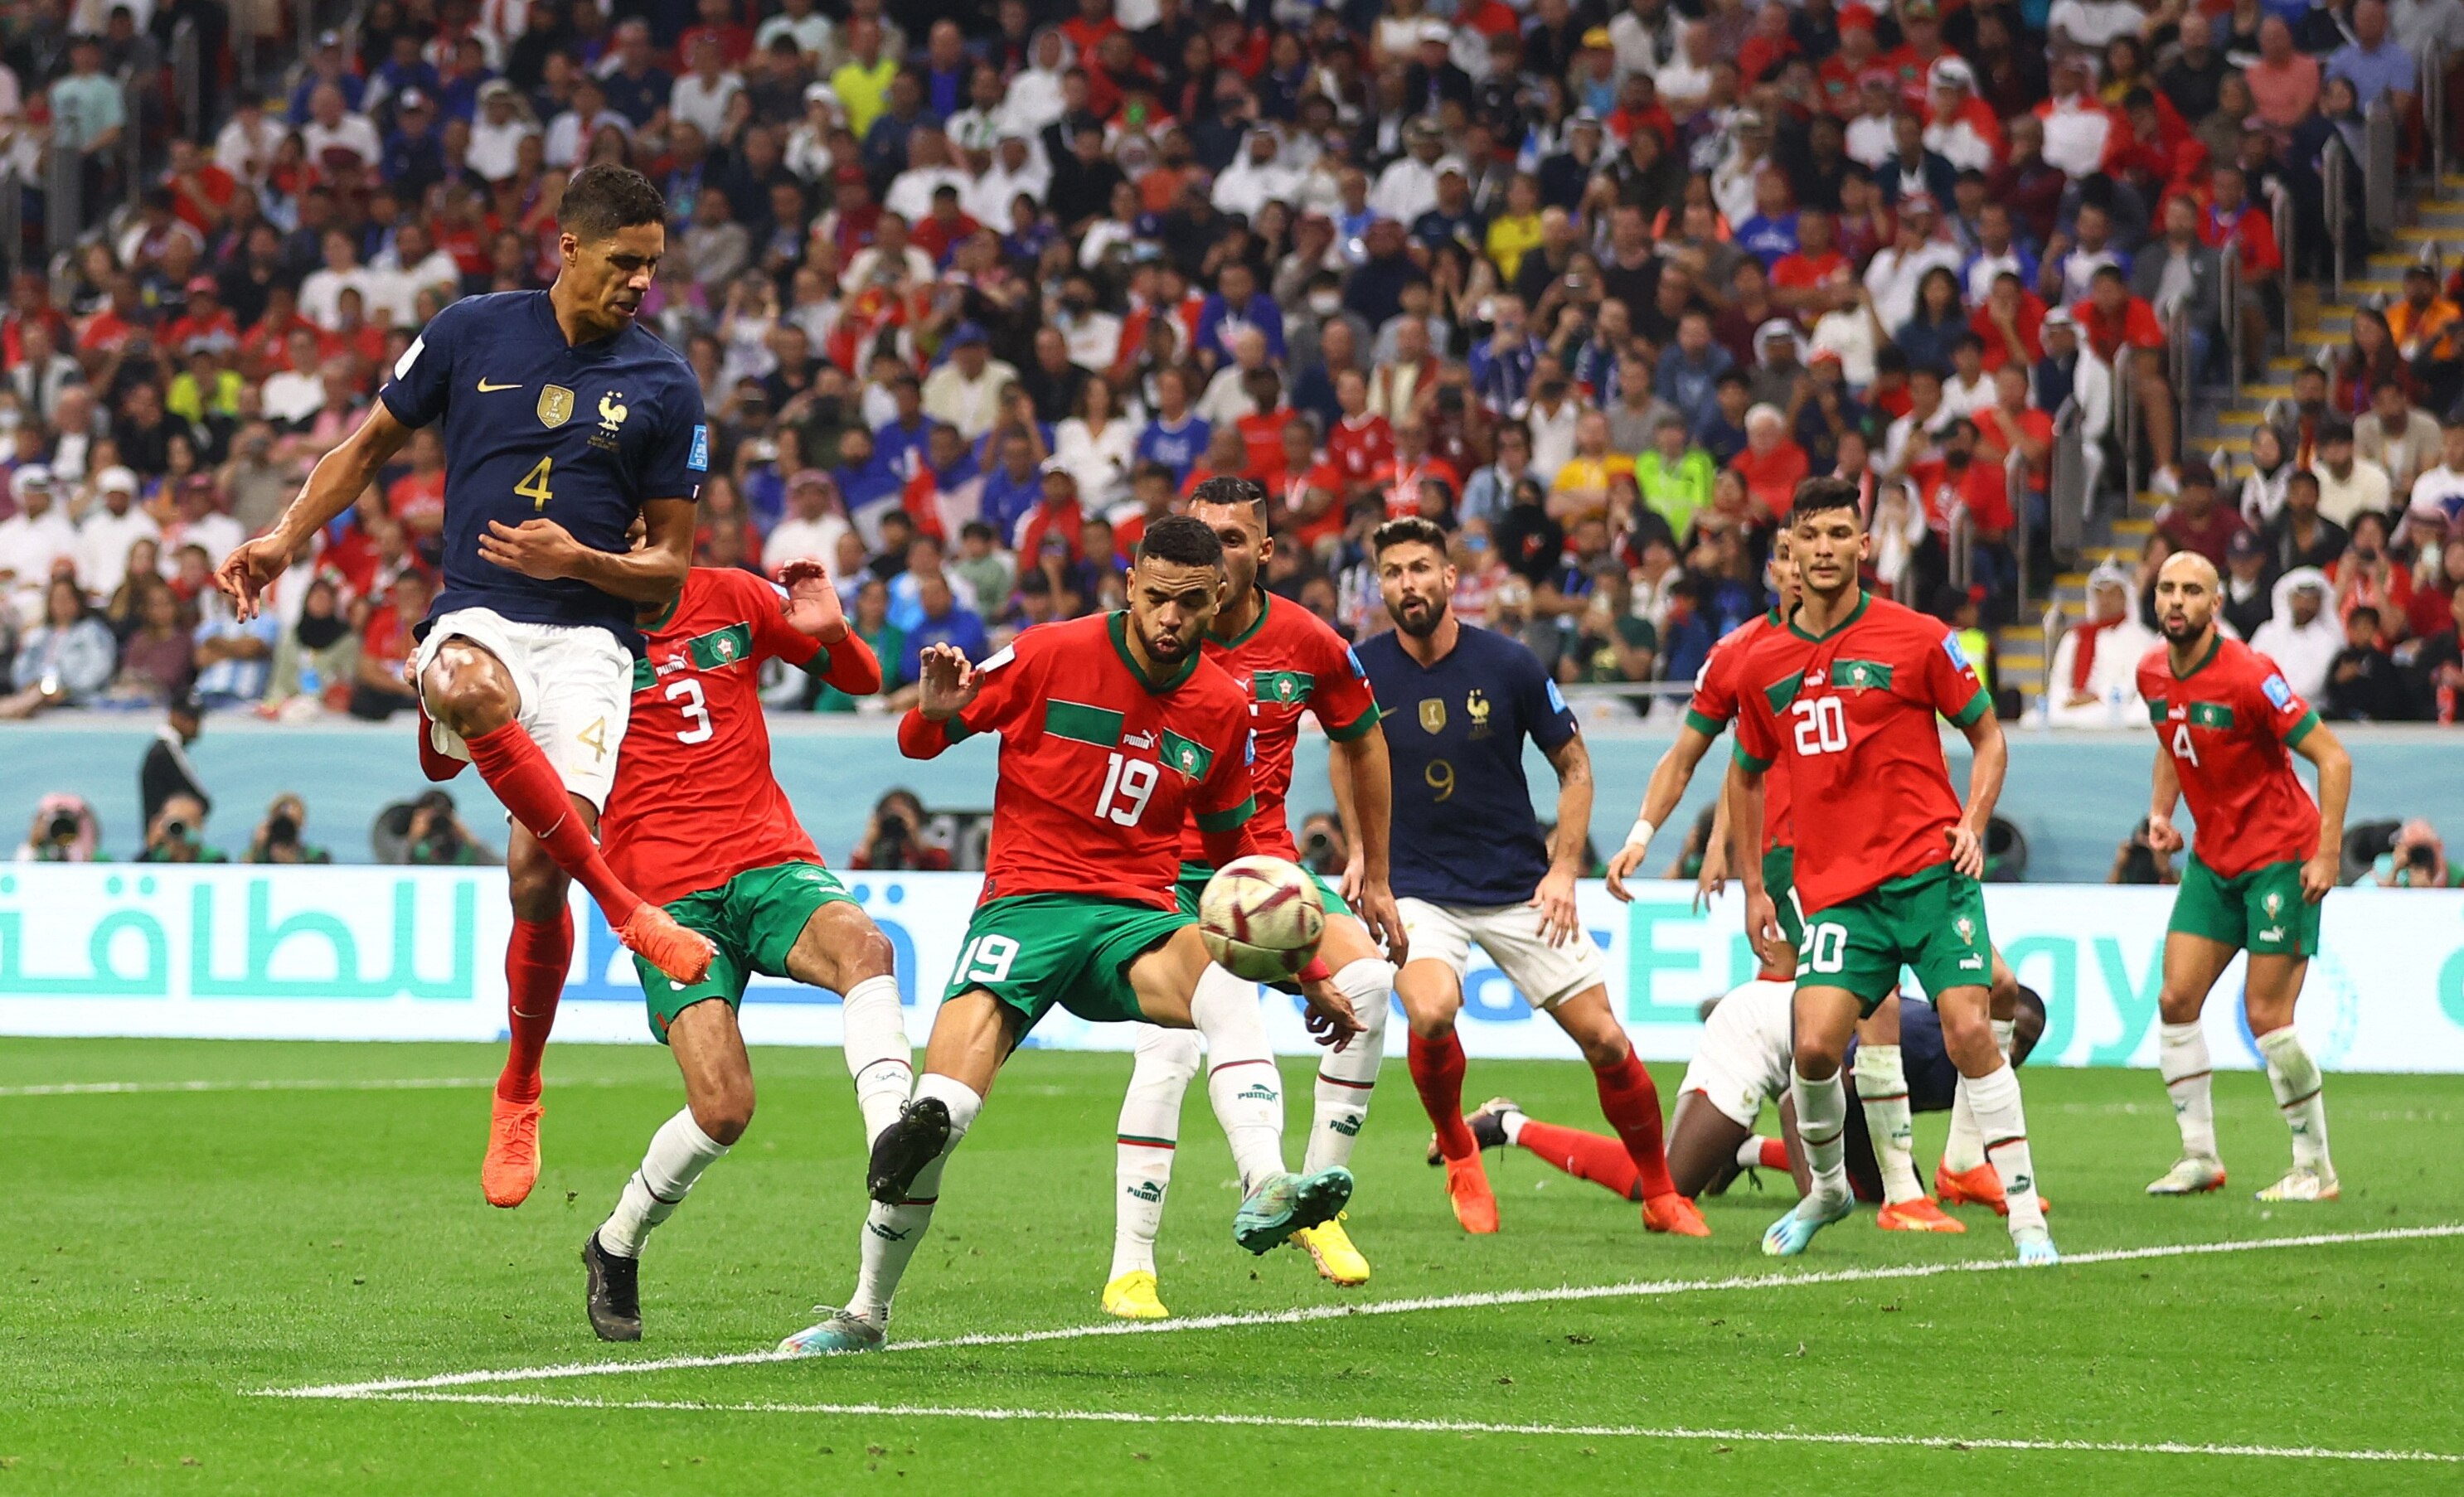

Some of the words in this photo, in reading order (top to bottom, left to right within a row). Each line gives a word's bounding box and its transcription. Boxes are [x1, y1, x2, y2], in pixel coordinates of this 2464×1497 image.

[513, 455, 554, 512] 4
[664, 677, 714, 744] 3
[1791, 695, 1848, 757] 20
[576, 715, 608, 763] 4
[1123, 734, 1151, 750] PUMA
[2172, 723, 2199, 768] 4
[1094, 752, 1160, 827] 19
[1424, 758, 1455, 802] 9
[952, 933, 1021, 986] 19
[1795, 922, 1848, 979] 20
